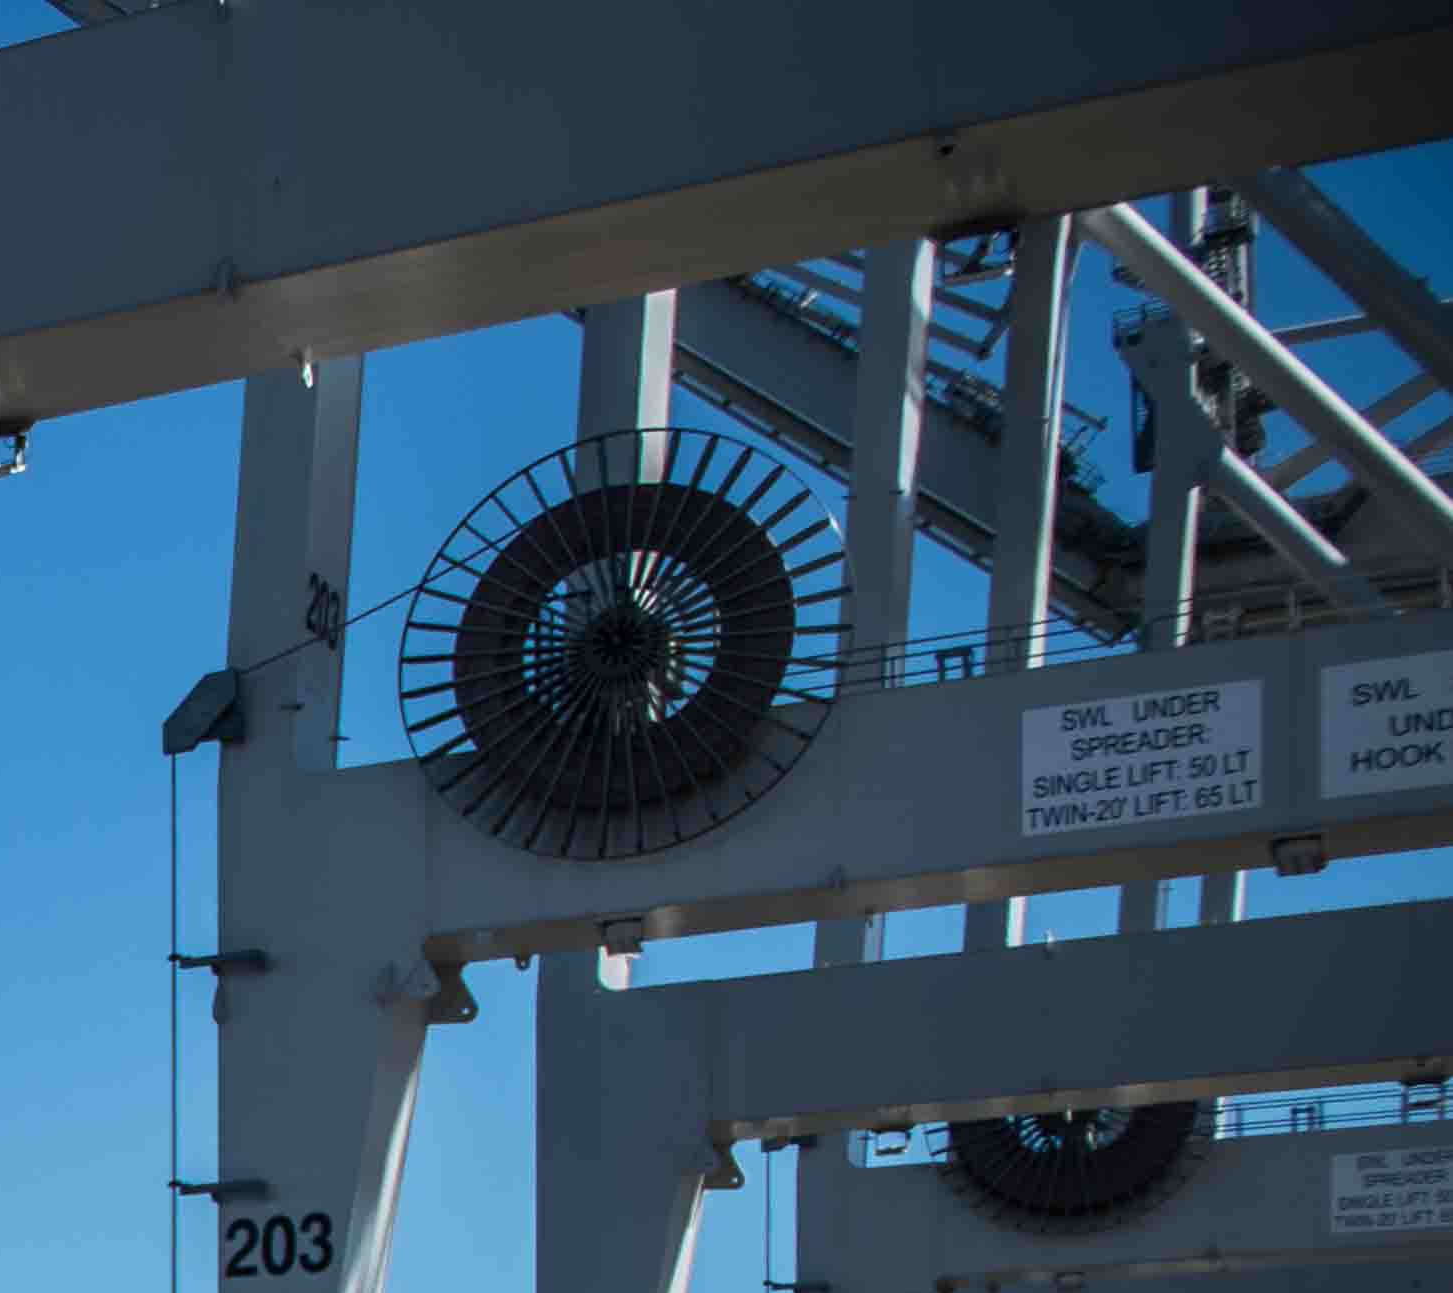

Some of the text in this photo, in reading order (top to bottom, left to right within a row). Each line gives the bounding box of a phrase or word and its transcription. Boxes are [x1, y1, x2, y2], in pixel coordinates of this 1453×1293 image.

[1352, 678, 1420, 707] SWL
[1060, 690, 1221, 732] SWL UNDER
[1032, 767, 1122, 799] SINGLE
[1188, 754, 1217, 779] 50
[1222, 749, 1253, 775] LT
[1351, 741, 1446, 772] HOOK
[1194, 784, 1224, 809] 65
[1230, 779, 1258, 805] LT
[225, 1212, 334, 1279] 203
